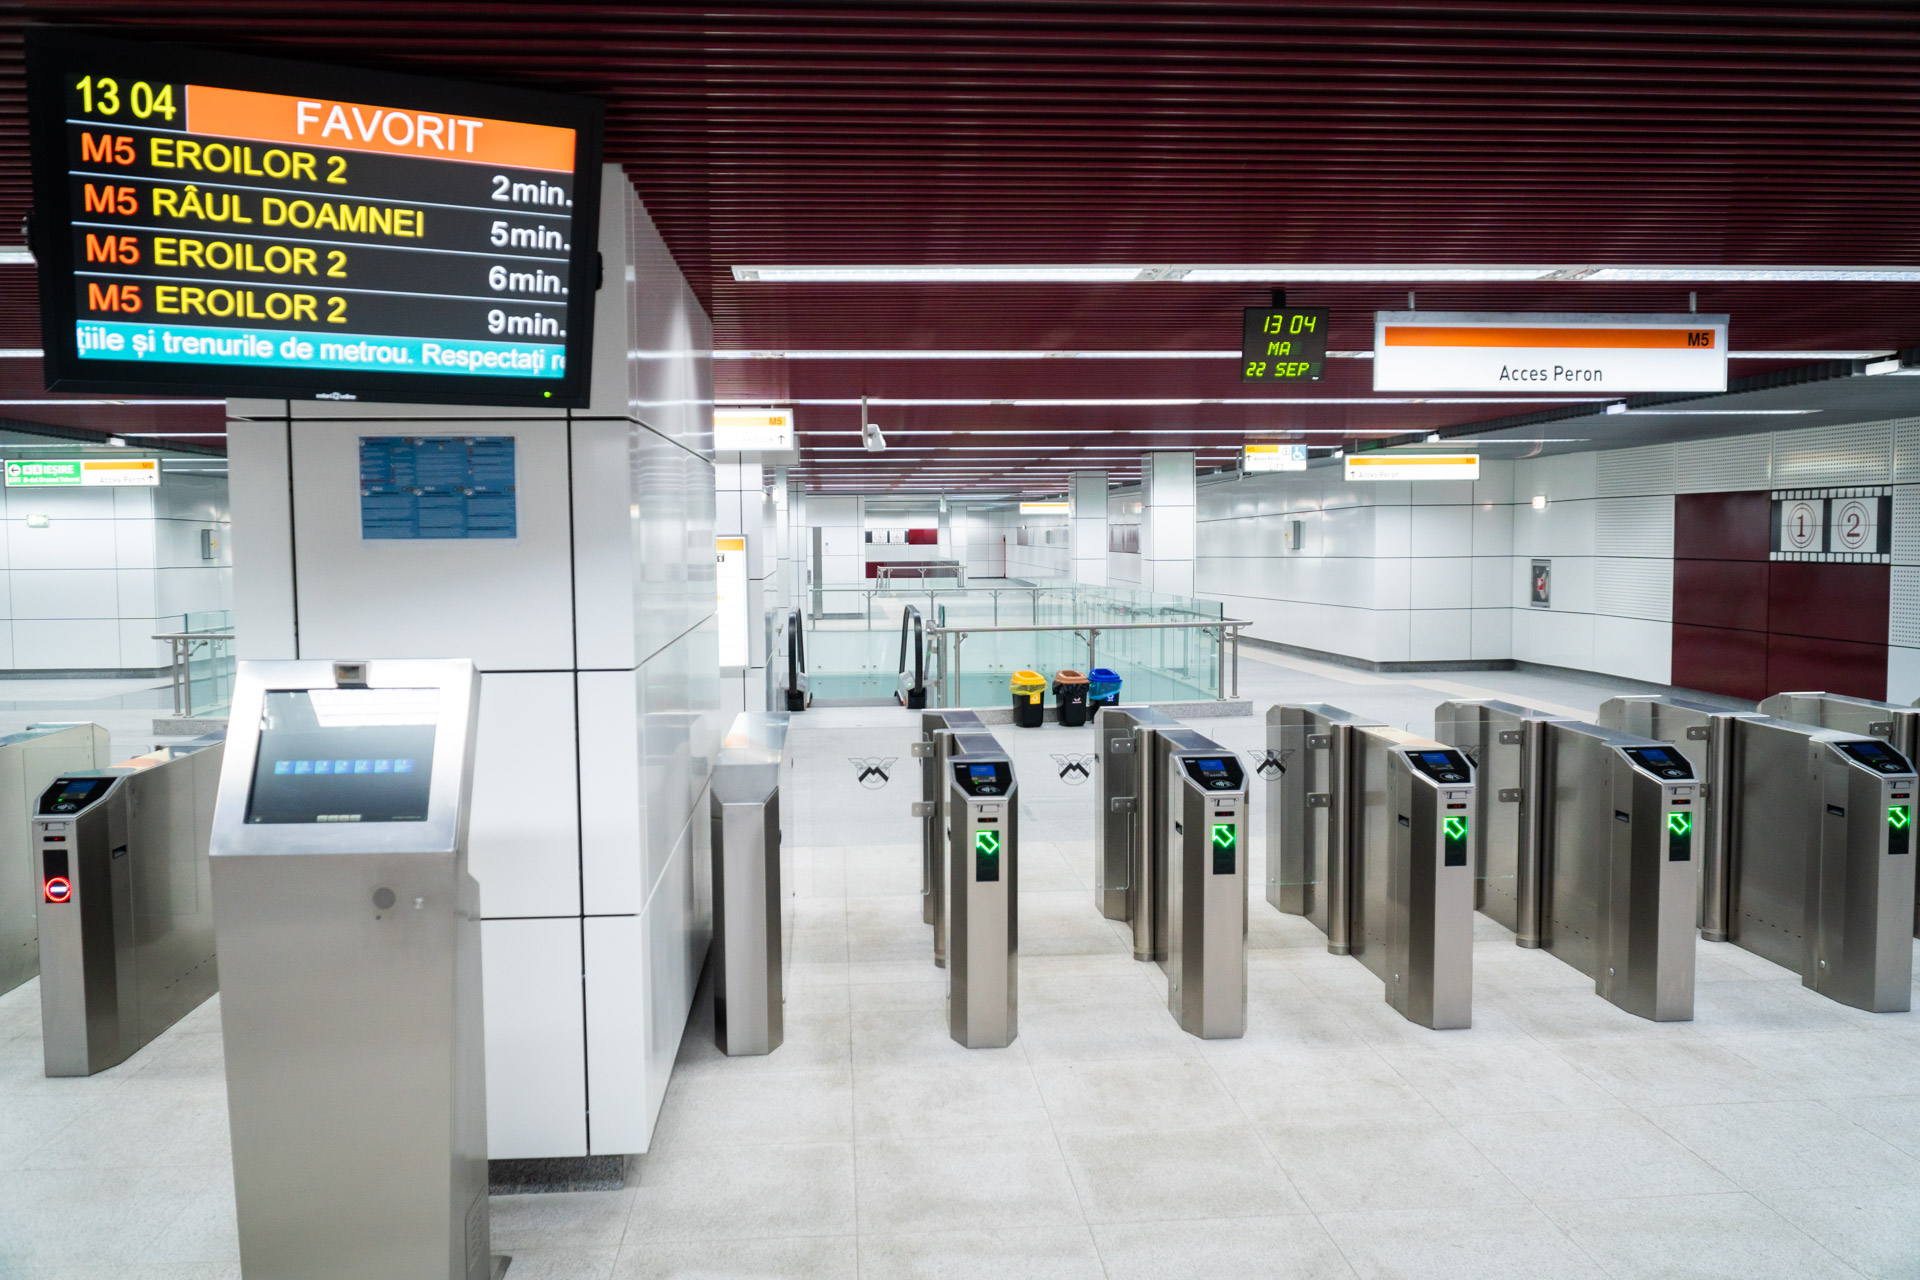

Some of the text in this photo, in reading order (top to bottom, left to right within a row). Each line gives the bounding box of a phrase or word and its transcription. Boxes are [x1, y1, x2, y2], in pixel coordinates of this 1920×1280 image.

[76, 75, 177, 121] 13 04
[297, 101, 483, 153] FAVORIT
[81, 132, 573, 207] M5 EROILOR 2 2min.
[84, 183, 571, 251] M5 RÂUL DOAMNEI 5min.
[86, 233, 569, 294] M5 EROILOR 2 6min.
[88, 283, 567, 337] M5 EROILOR 2 9min.
[1264, 315, 1317, 334] 13 04
[132, 329, 155, 359] și
[162, 331, 274, 358] trenurile
[279, 336, 314, 360] de
[320, 341, 414, 364] metrou.
[422, 343, 546, 375] Respectați
[1267, 341, 1291, 356] MA
[1687, 332, 1710, 347] M5
[1246, 362, 1310, 377] 22 SEP
[1499, 365, 1603, 382] Acces Peron
[768, 416, 783, 426] M5
[1796, 513, 1860, 538] 1 2
